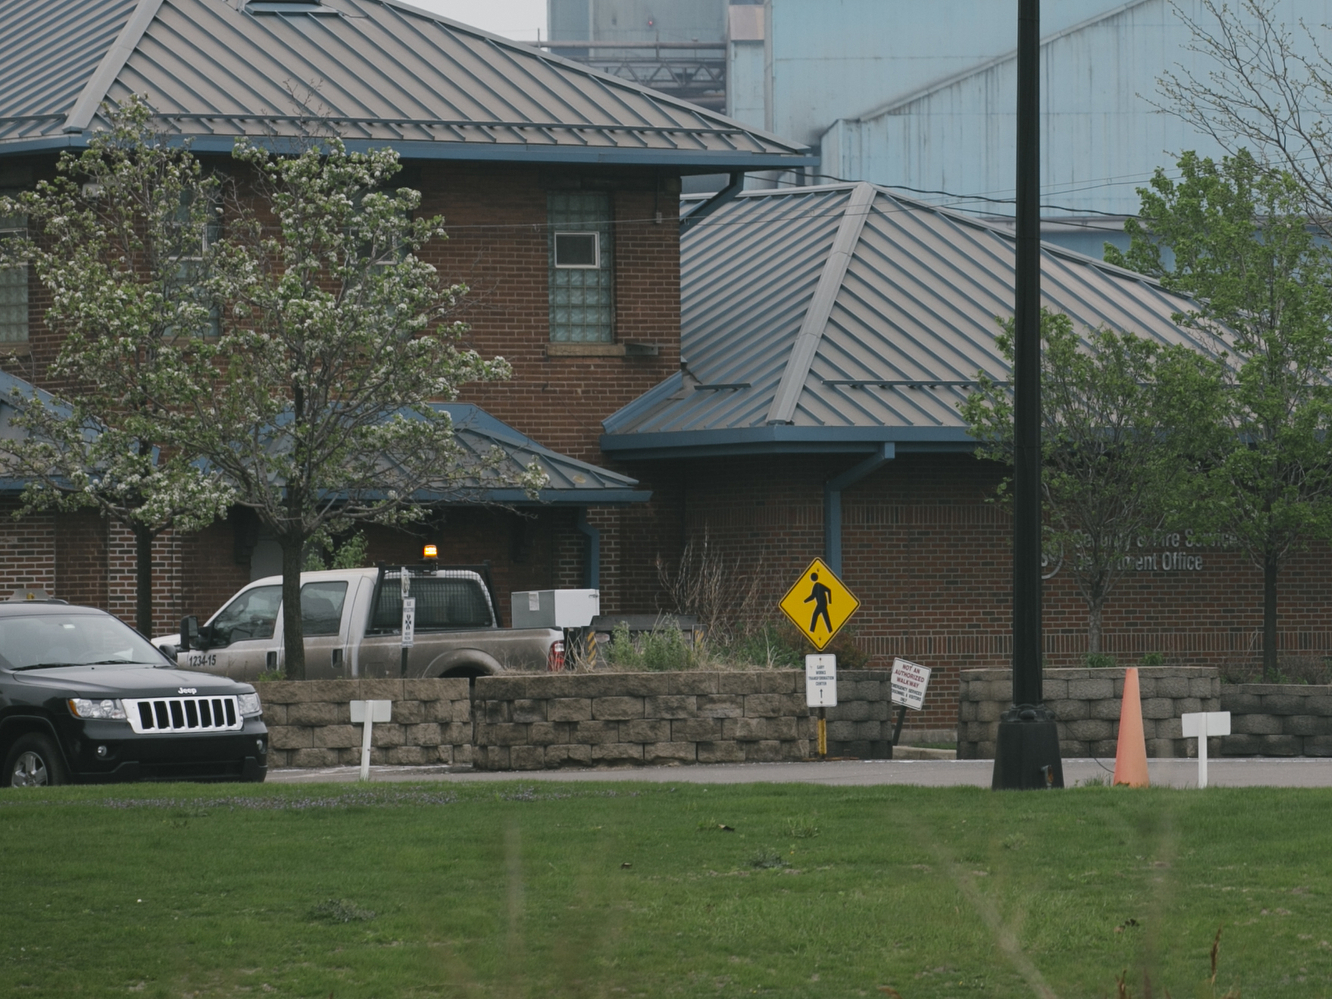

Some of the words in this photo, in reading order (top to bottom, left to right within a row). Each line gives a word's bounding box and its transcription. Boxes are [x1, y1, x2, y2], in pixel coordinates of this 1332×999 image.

[1162, 552, 1203, 571] Office
[189, 654, 217, 667] 1234-15
[902, 663, 913, 672] NOT
[895, 669, 925, 683] AUTHORIZED
[896, 676, 920, 688] WALKWAY
[177, 687, 197, 695] Jeep
